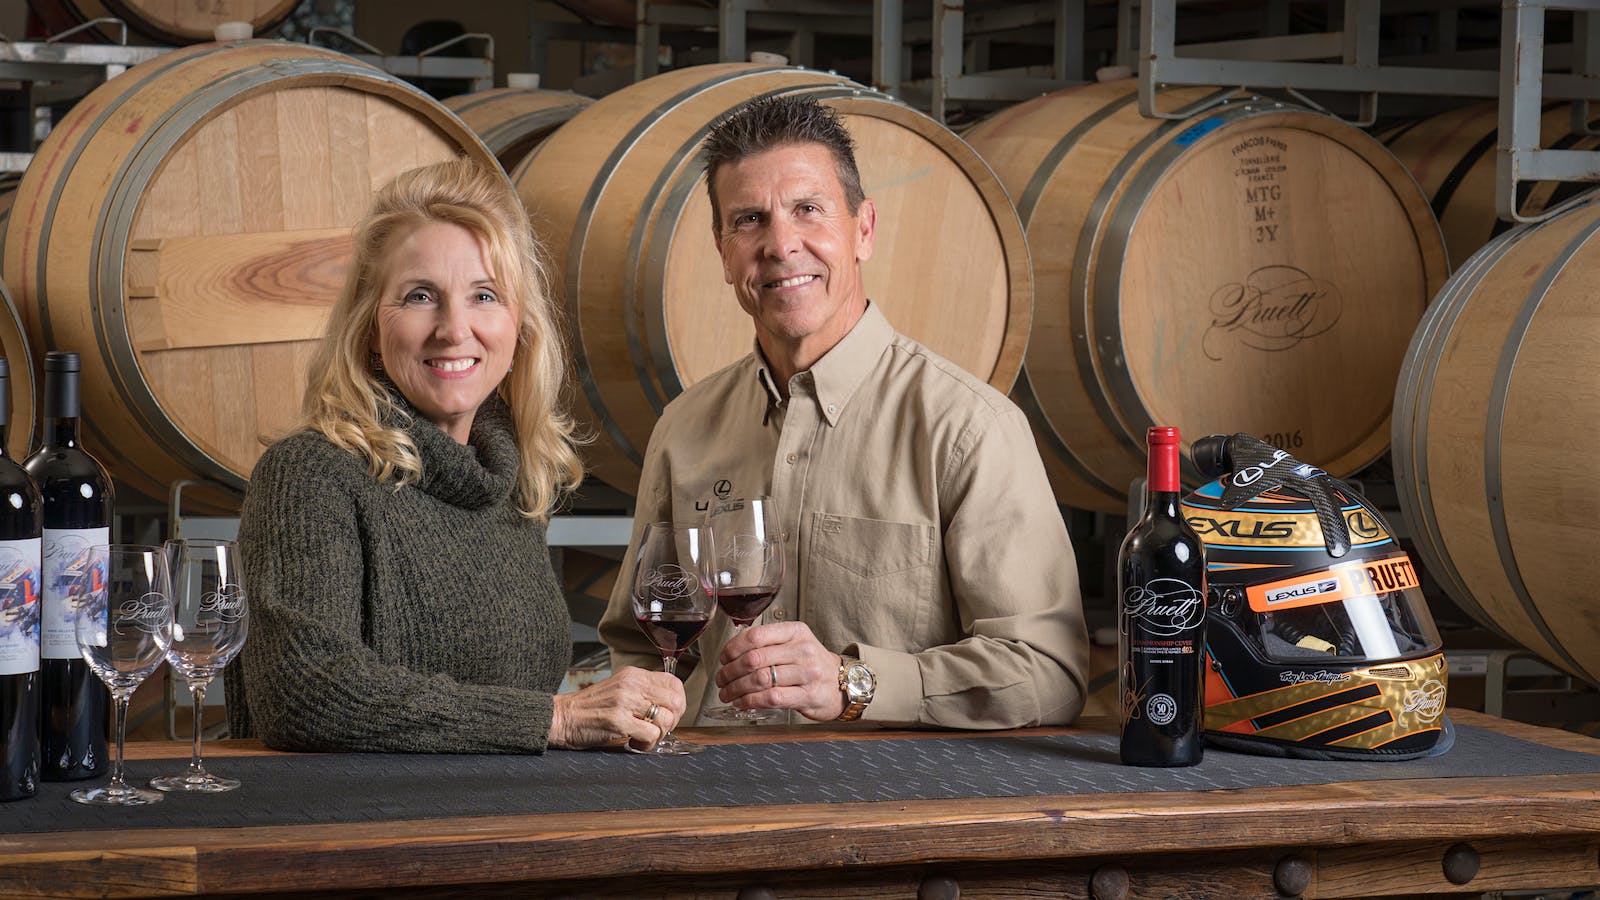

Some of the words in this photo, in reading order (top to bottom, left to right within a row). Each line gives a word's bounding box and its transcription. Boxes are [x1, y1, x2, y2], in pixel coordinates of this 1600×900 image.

[1246, 185, 1281, 203] MTG
[1256, 225, 1278, 243] 3Y
[1186, 516, 1297, 538] EXUS
[1266, 586, 1317, 602] LEXUS
[1123, 582, 1203, 625] Pruett
